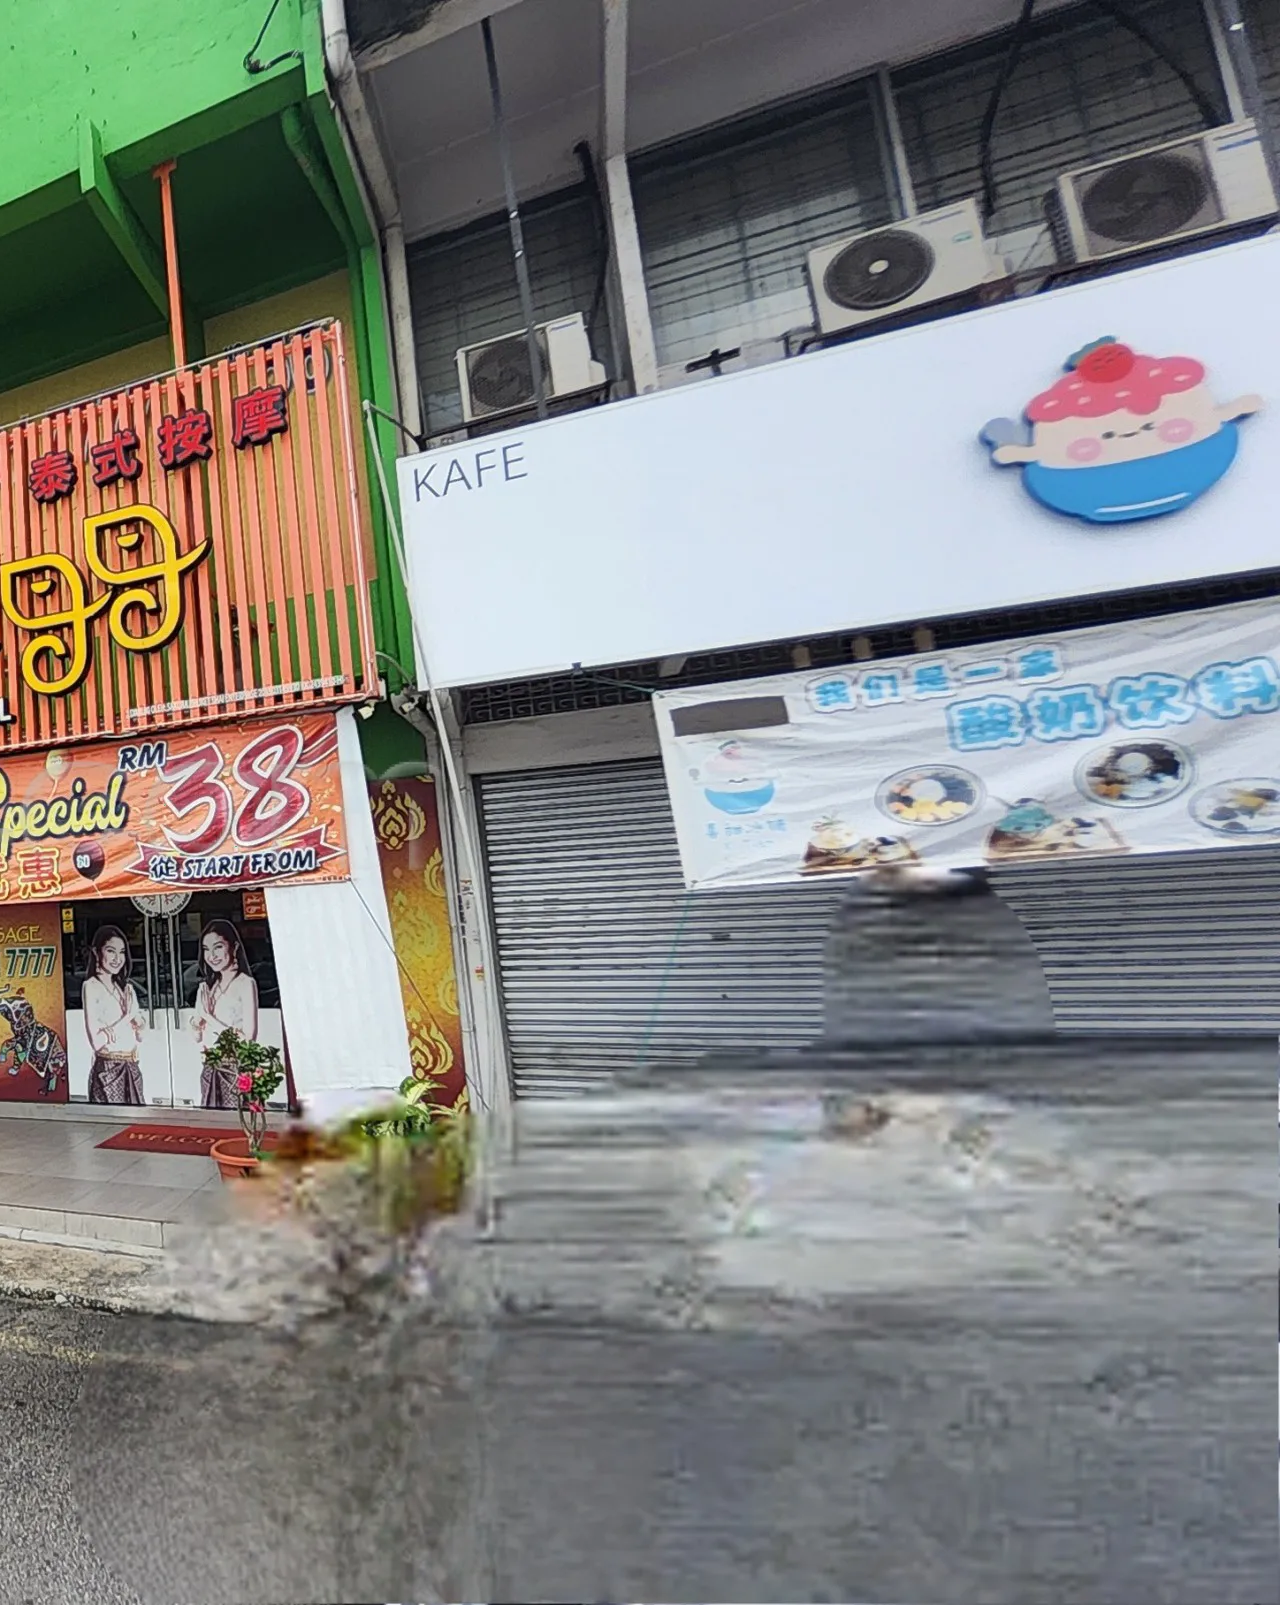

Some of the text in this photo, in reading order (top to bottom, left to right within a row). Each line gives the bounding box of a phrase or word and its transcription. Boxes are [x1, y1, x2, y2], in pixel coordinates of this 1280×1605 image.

[28, 384, 288, 503] 泰式按摩
[413, 441, 528, 503] KAFE
[118, 724, 310, 857] RM 38
[181, 853, 244, 878] START
[249, 847, 317, 874] FROM
[5, 946, 57, 979] 7777
[127, 1131, 217, 1145] WELCO
